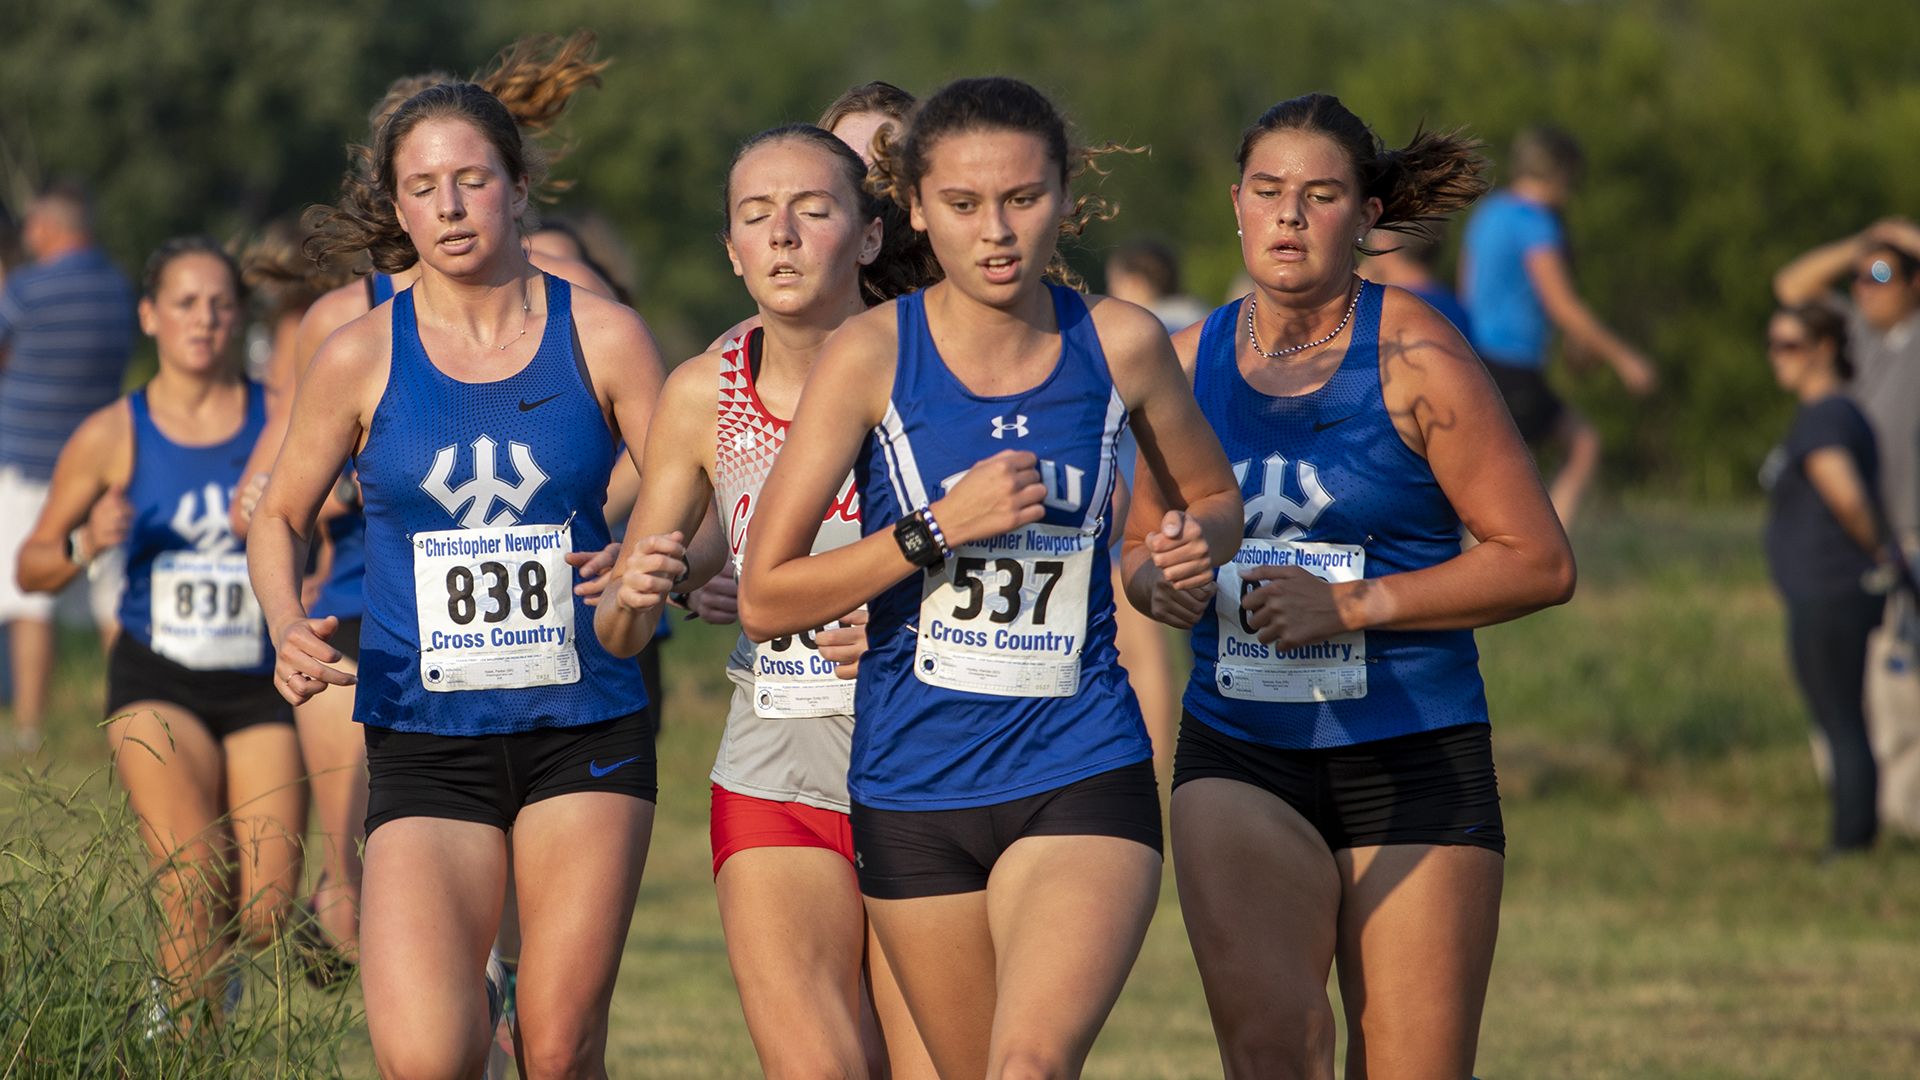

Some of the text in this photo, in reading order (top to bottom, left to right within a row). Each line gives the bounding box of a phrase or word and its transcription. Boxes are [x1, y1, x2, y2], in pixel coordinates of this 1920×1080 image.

[426, 530, 561, 558] Christopher Newport
[1026, 530, 1082, 555] Newport
[1232, 545, 1352, 571] hristopher Newport
[446, 560, 549, 625] 838
[952, 557, 1064, 625] 537
[432, 625, 566, 650] Cross Country
[931, 620, 1074, 656] Cross Country
[1227, 636, 1269, 659] Cross
[760, 655, 804, 675] Cross
